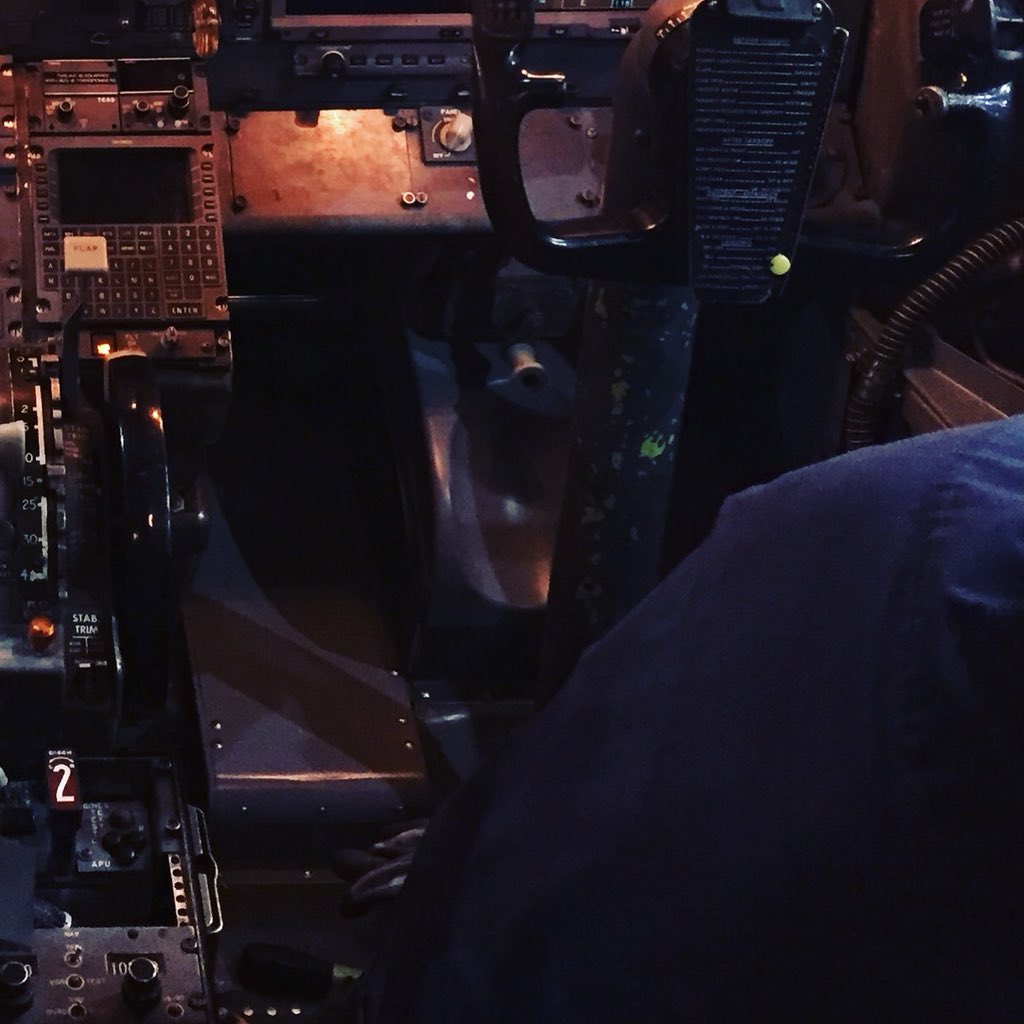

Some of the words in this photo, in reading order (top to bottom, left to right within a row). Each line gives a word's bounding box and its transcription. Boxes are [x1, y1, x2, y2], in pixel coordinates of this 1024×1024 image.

[20, 404, 28, 414] 2
[22, 498, 36, 510] 25
[24, 534, 38, 544] 30
[72, 614, 98, 623] STAB
[76, 625, 98, 634] TRIM
[52, 764, 75, 802] 2
[92, 860, 110, 868] APU
